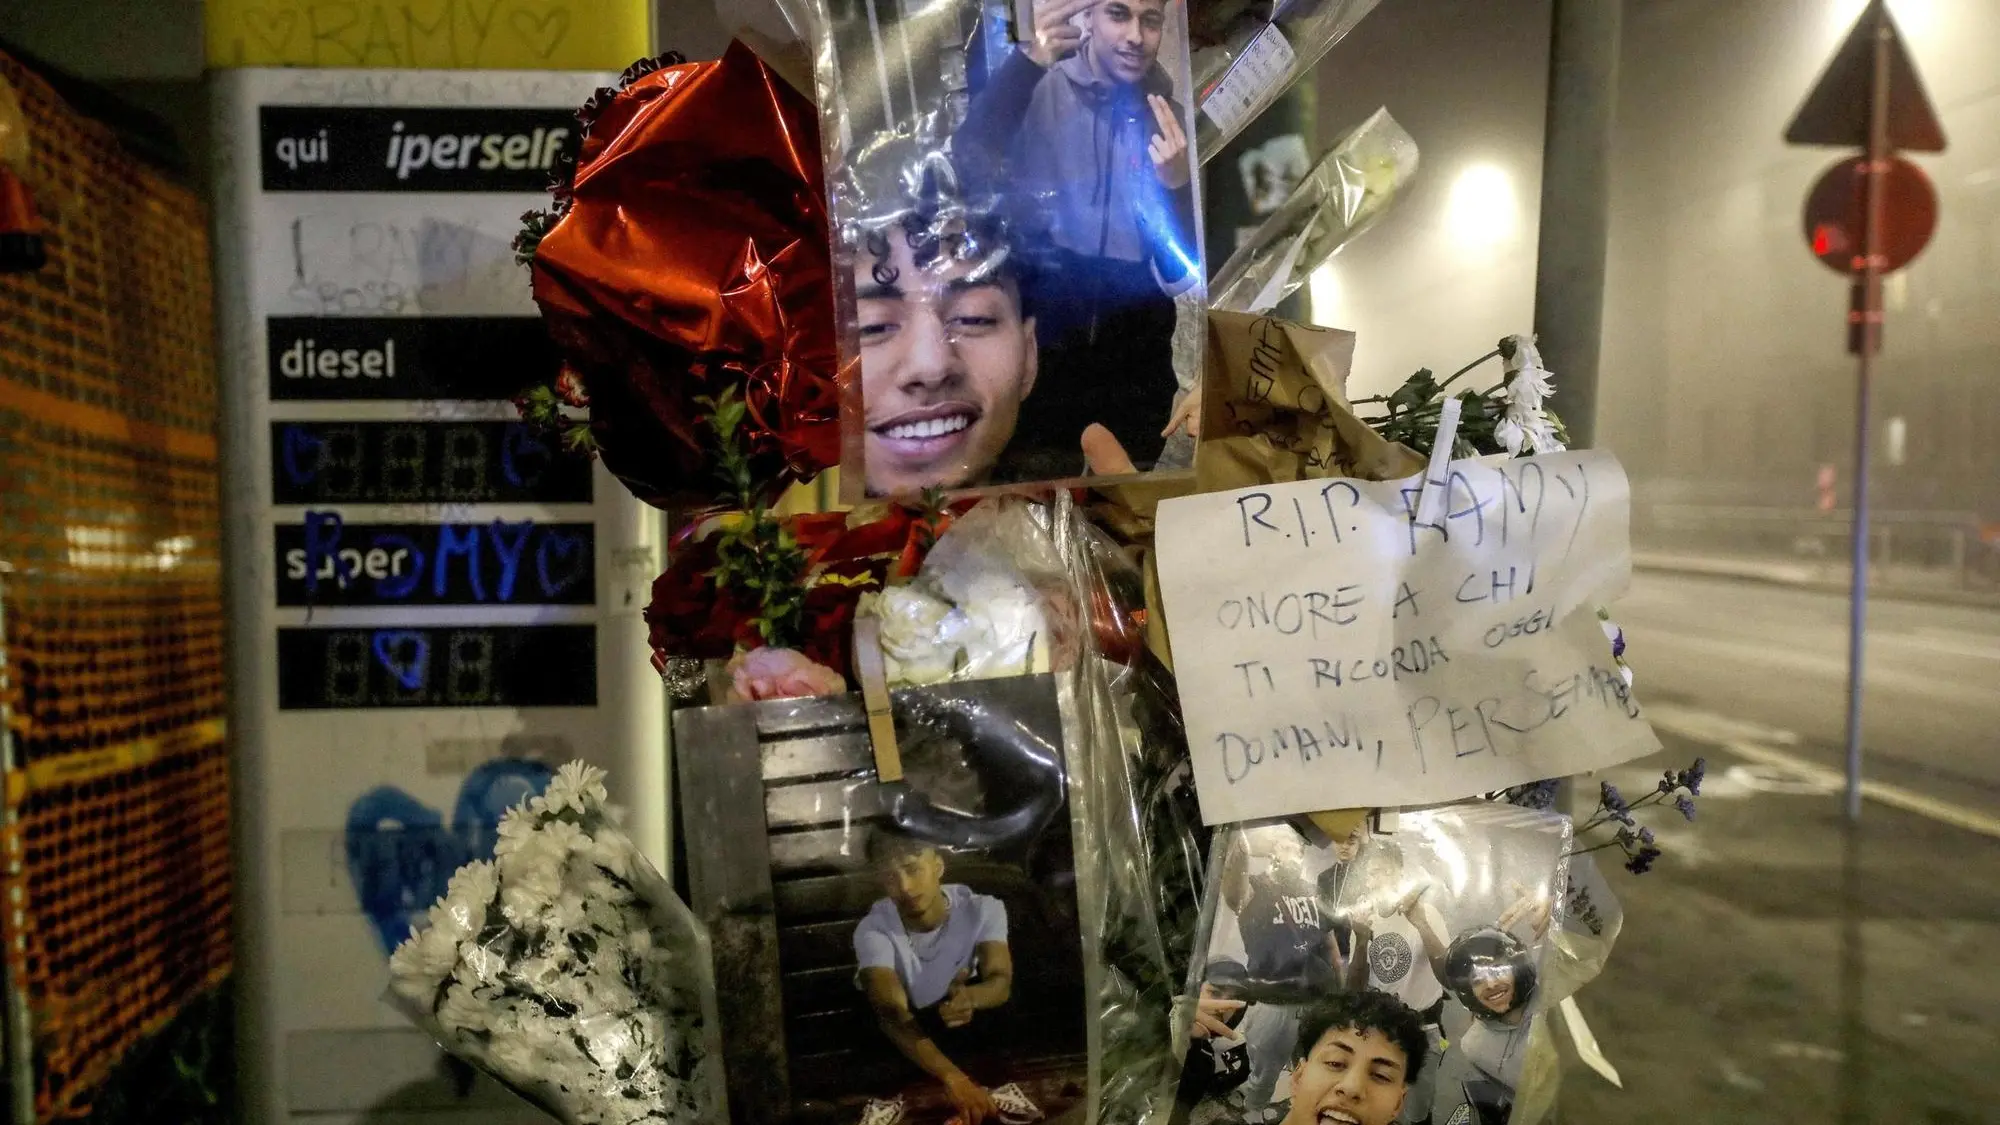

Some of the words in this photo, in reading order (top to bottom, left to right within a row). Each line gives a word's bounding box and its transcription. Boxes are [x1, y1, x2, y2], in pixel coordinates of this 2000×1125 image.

[308, 1, 500, 67] RAMY
[275, 128, 329, 170] qui
[385, 120, 569, 180] iperself
[280, 339, 396, 378] diesel
[1236, 481, 1360, 547] R.I.P.
[1401, 462, 1589, 560] RAMY
[1217, 584, 1366, 640] ONORE
[1391, 582, 1423, 619] A
[1456, 562, 1536, 604] CHI
[1234, 660, 1275, 698] TI
[1307, 635, 1450, 687] RICORDA
[1484, 605, 1556, 648] OGGI
[1407, 695, 1522, 774] PER
